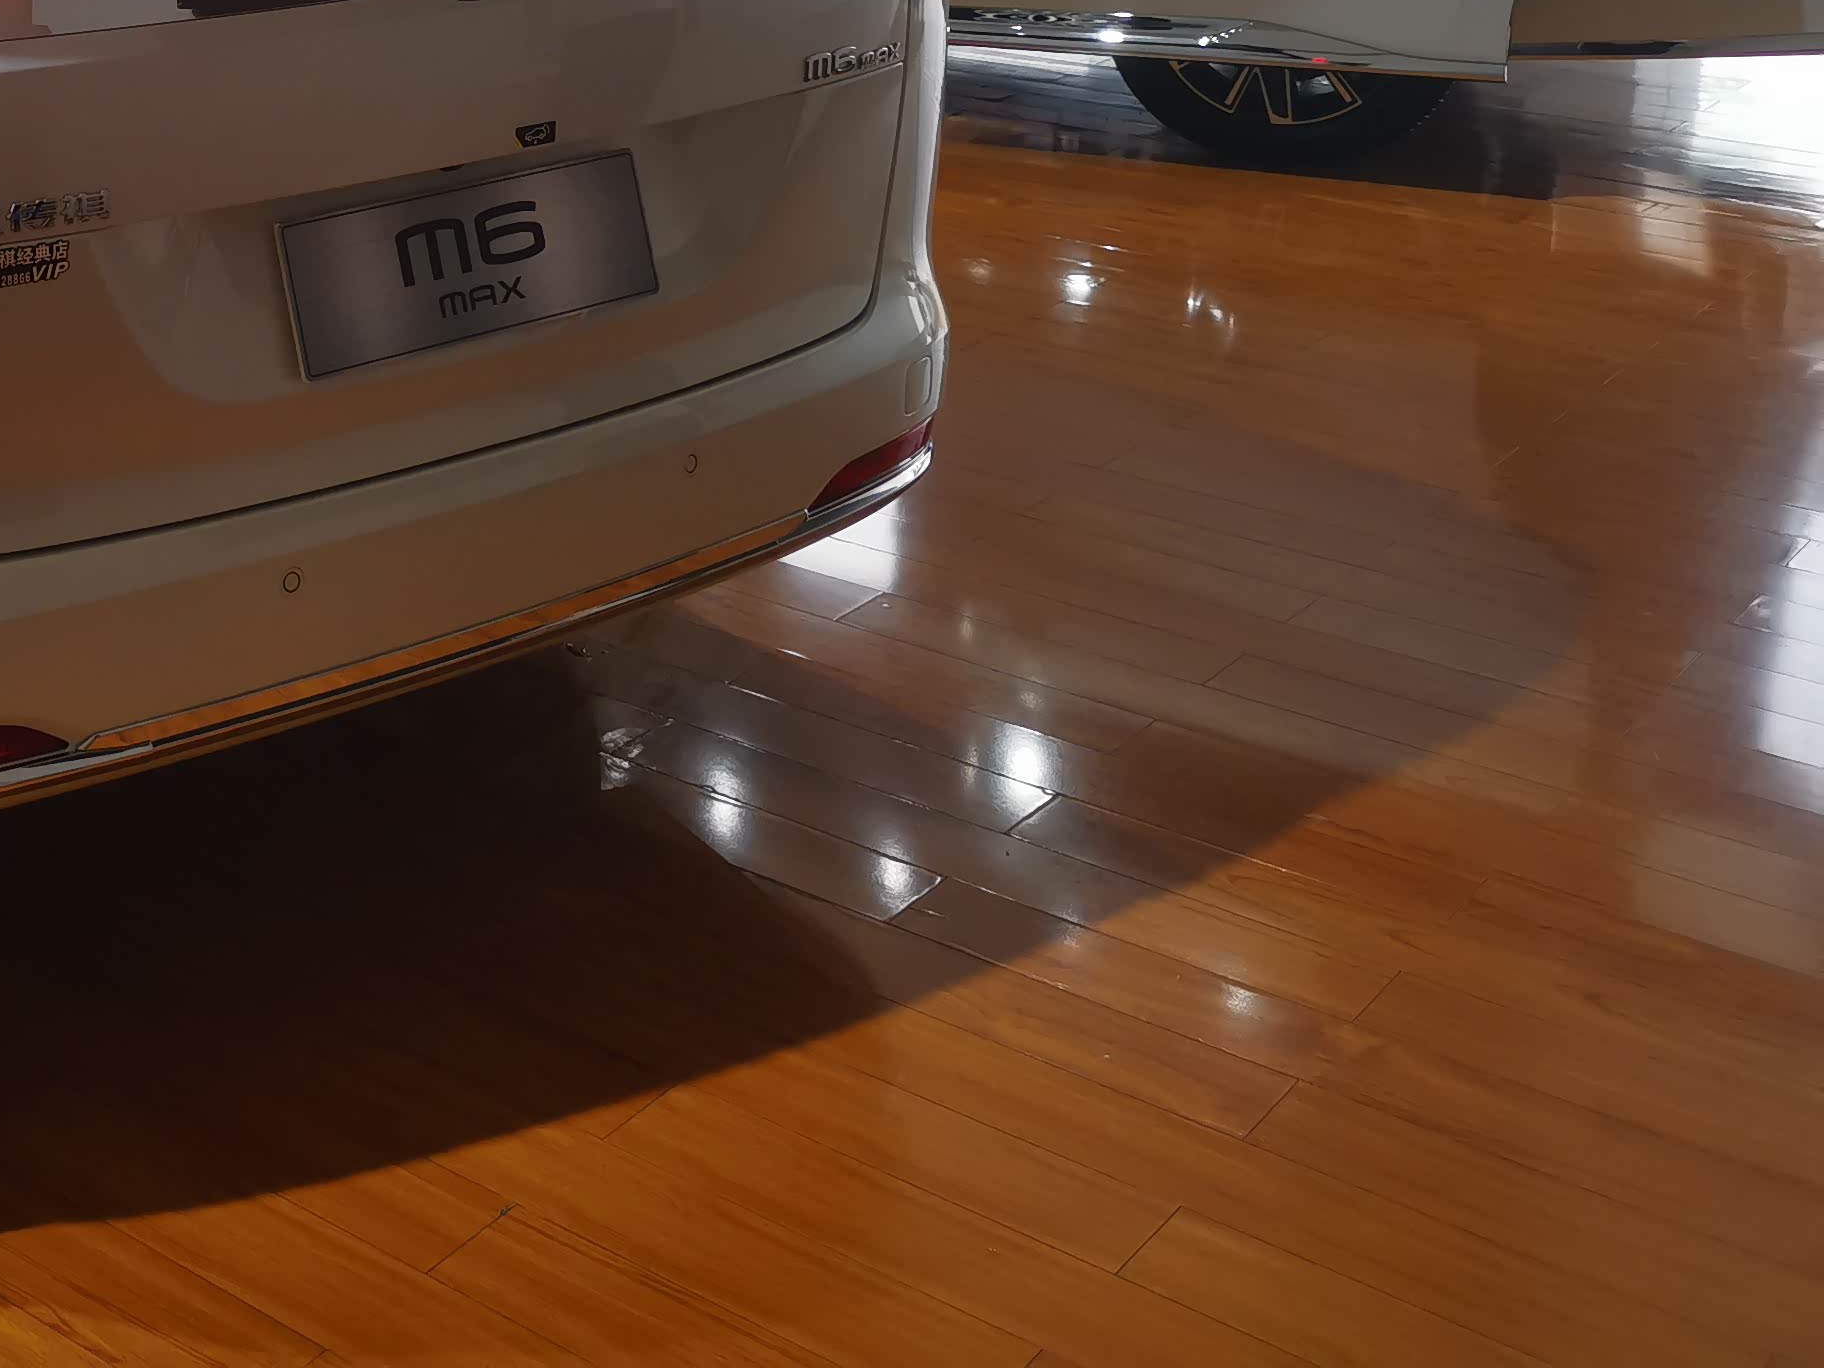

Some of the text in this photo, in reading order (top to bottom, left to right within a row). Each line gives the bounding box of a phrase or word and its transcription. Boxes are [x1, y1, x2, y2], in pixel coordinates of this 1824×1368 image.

[394, 200, 546, 288] M6
[32, 261, 70, 282] VIP
[438, 275, 526, 319] MAX
